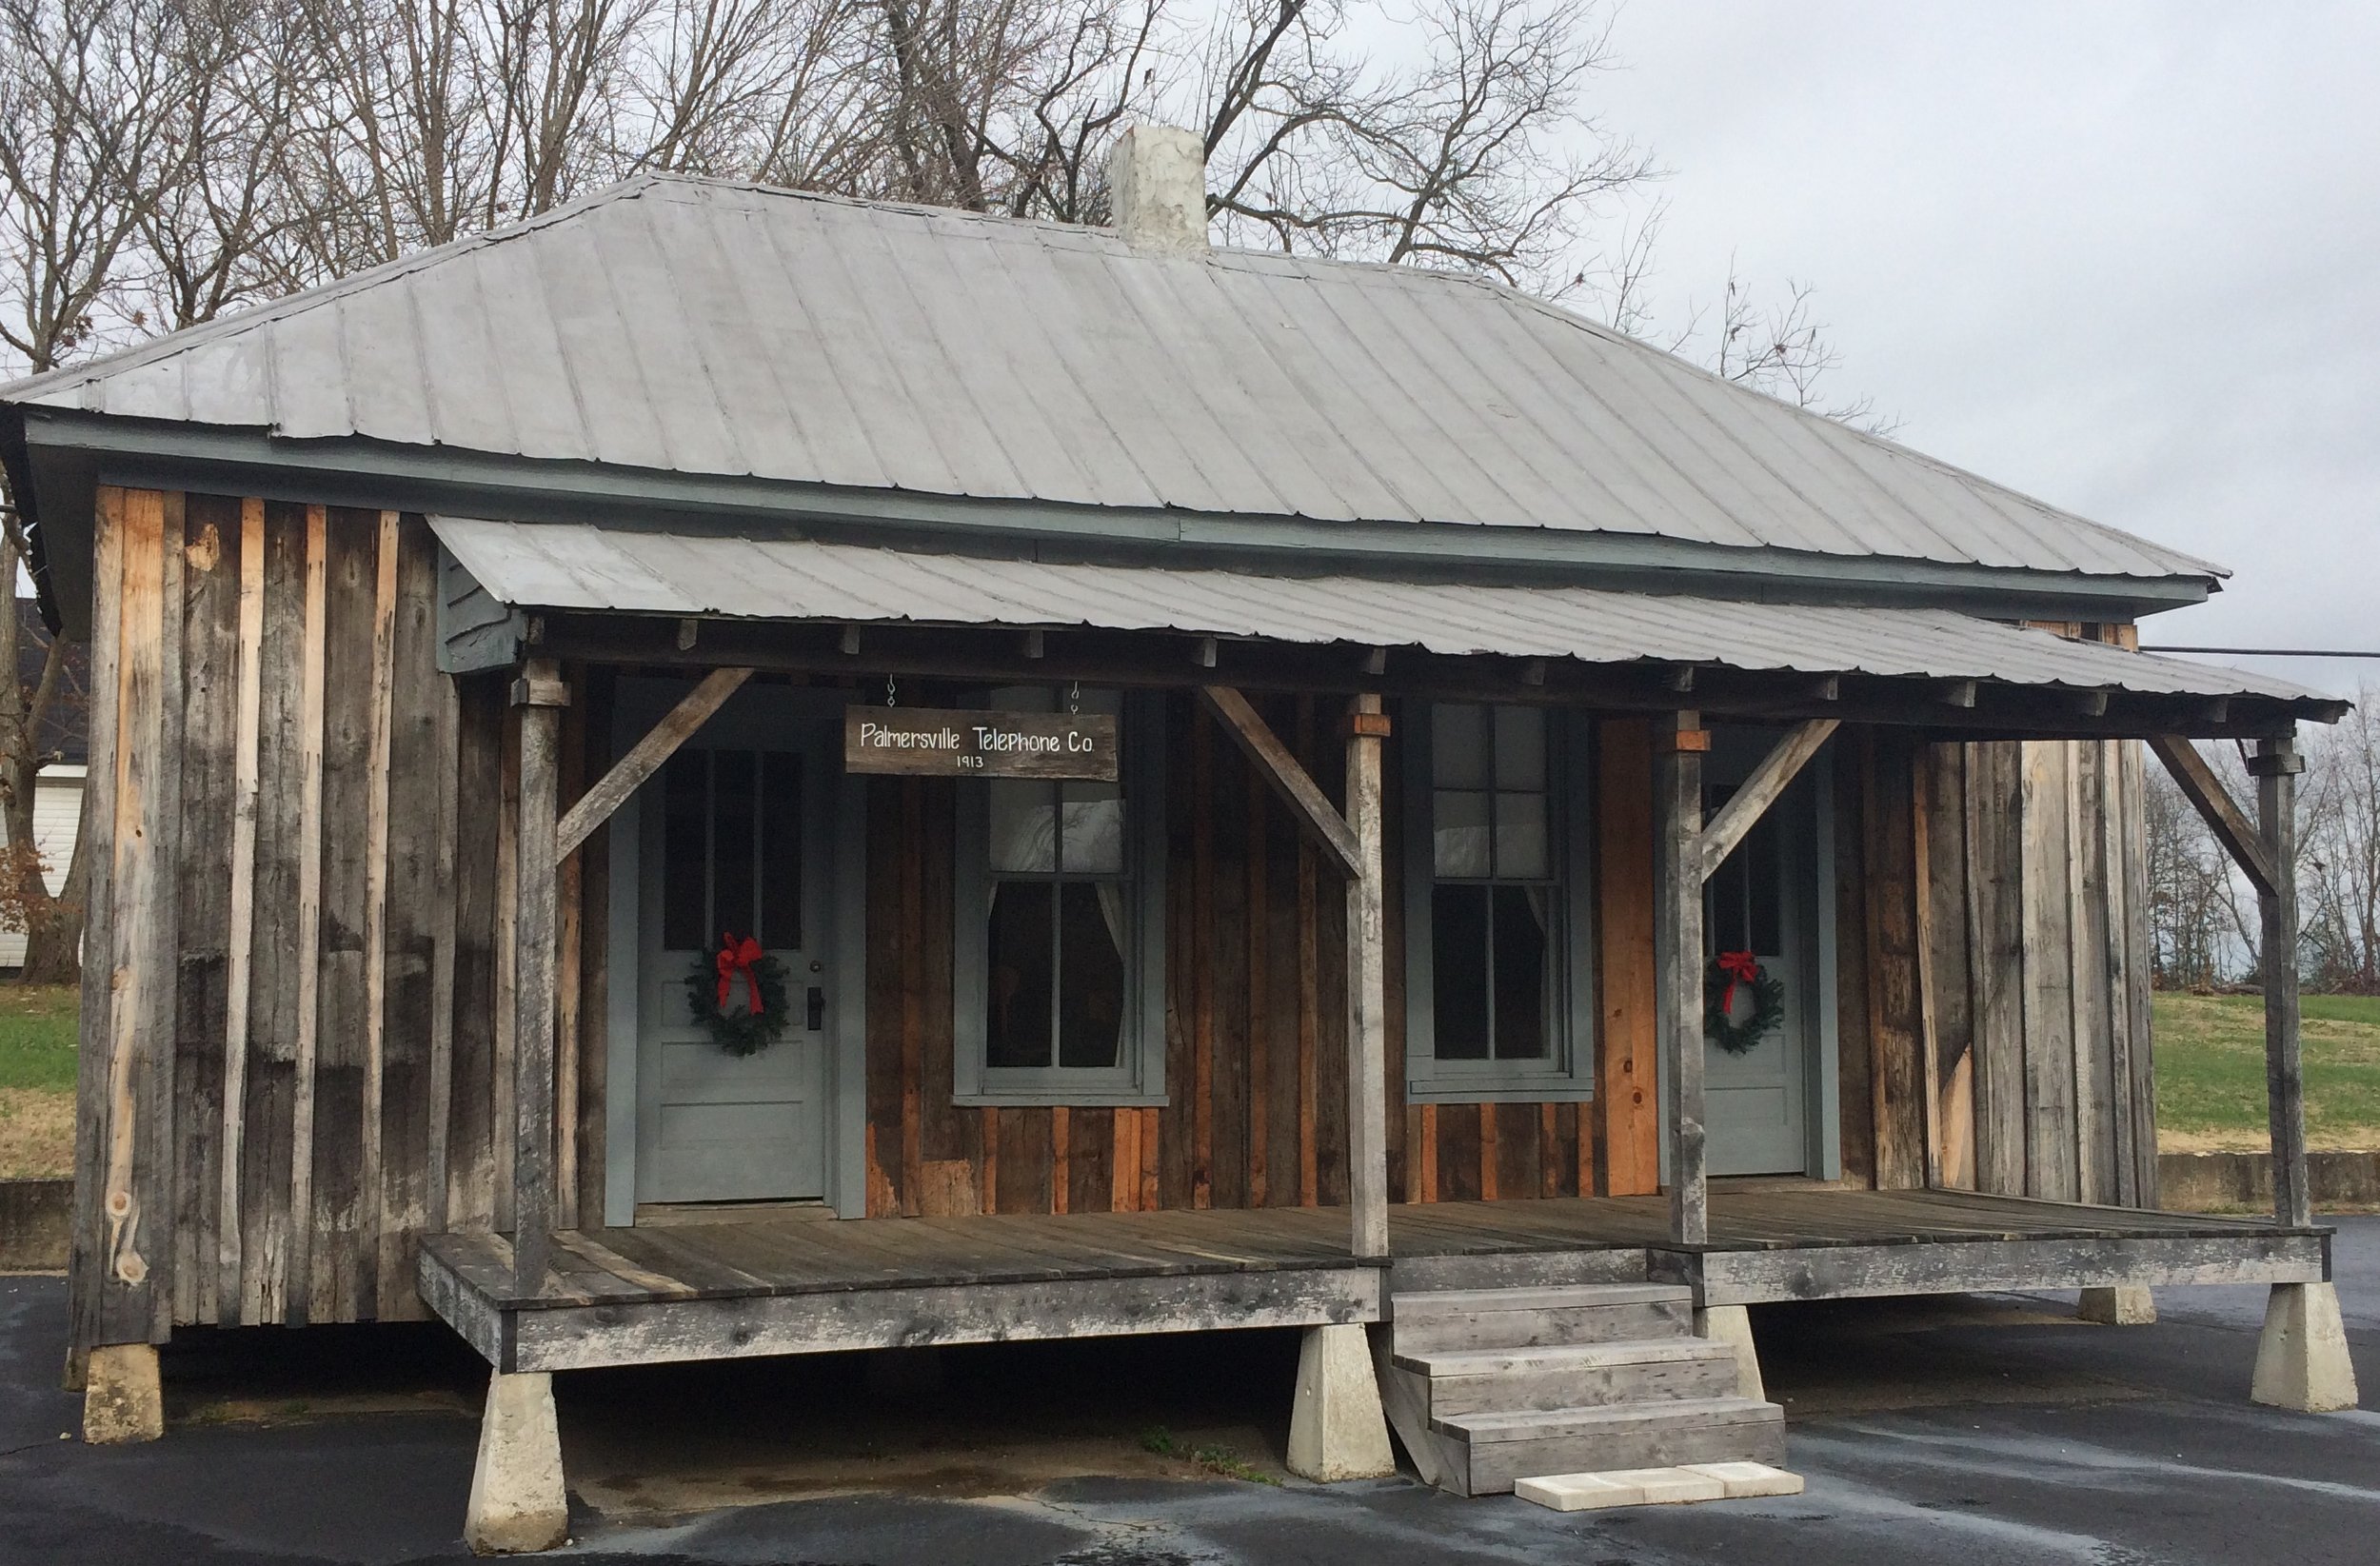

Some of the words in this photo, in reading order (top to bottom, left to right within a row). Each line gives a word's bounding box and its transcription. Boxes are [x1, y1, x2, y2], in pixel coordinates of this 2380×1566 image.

[861, 723, 960, 750] Palmersville
[972, 726, 1061, 752] Telephone
[957, 756, 984, 768] 1913
